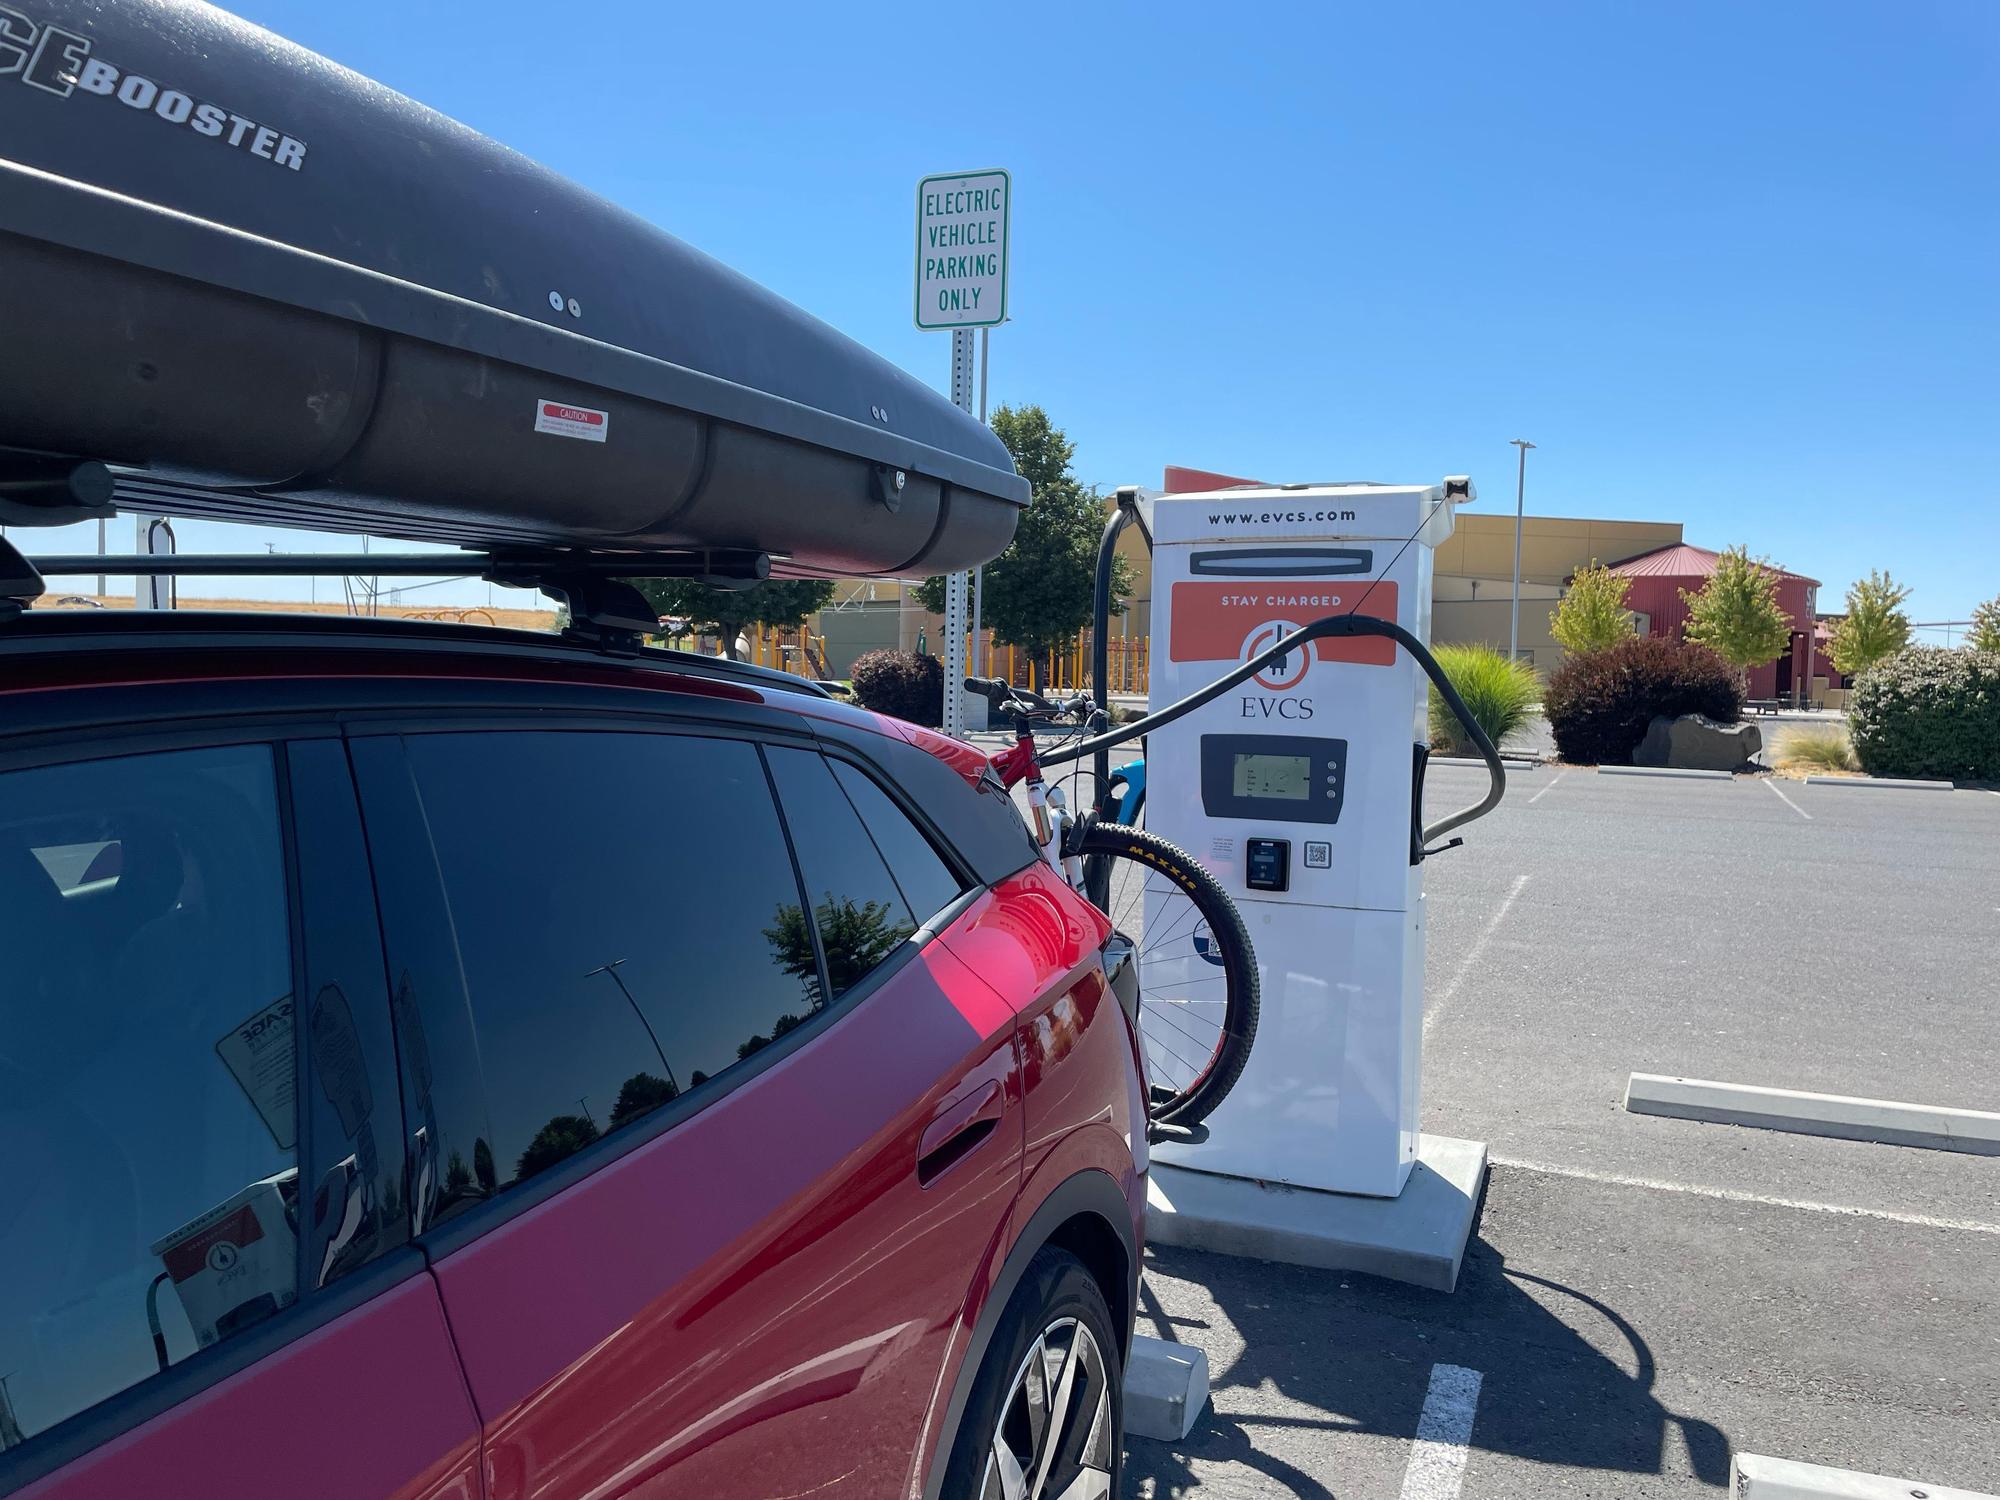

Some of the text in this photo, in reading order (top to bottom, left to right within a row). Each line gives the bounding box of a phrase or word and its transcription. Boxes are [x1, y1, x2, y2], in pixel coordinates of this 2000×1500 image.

[78, 57, 309, 171] BOOSTER
[926, 188, 1000, 217] ELECTRIC
[929, 221, 997, 248] VEHICLE
[926, 253, 997, 281] PARKING
[938, 287, 982, 311] ONLY
[560, 408, 588, 422] CAUTION
[1208, 508, 1356, 525] www.evcs.com
[1221, 595, 1342, 607] STAY CHARGED
[1239, 697, 1315, 720] EVCS
[1128, 845, 1197, 890] MAXXIS
